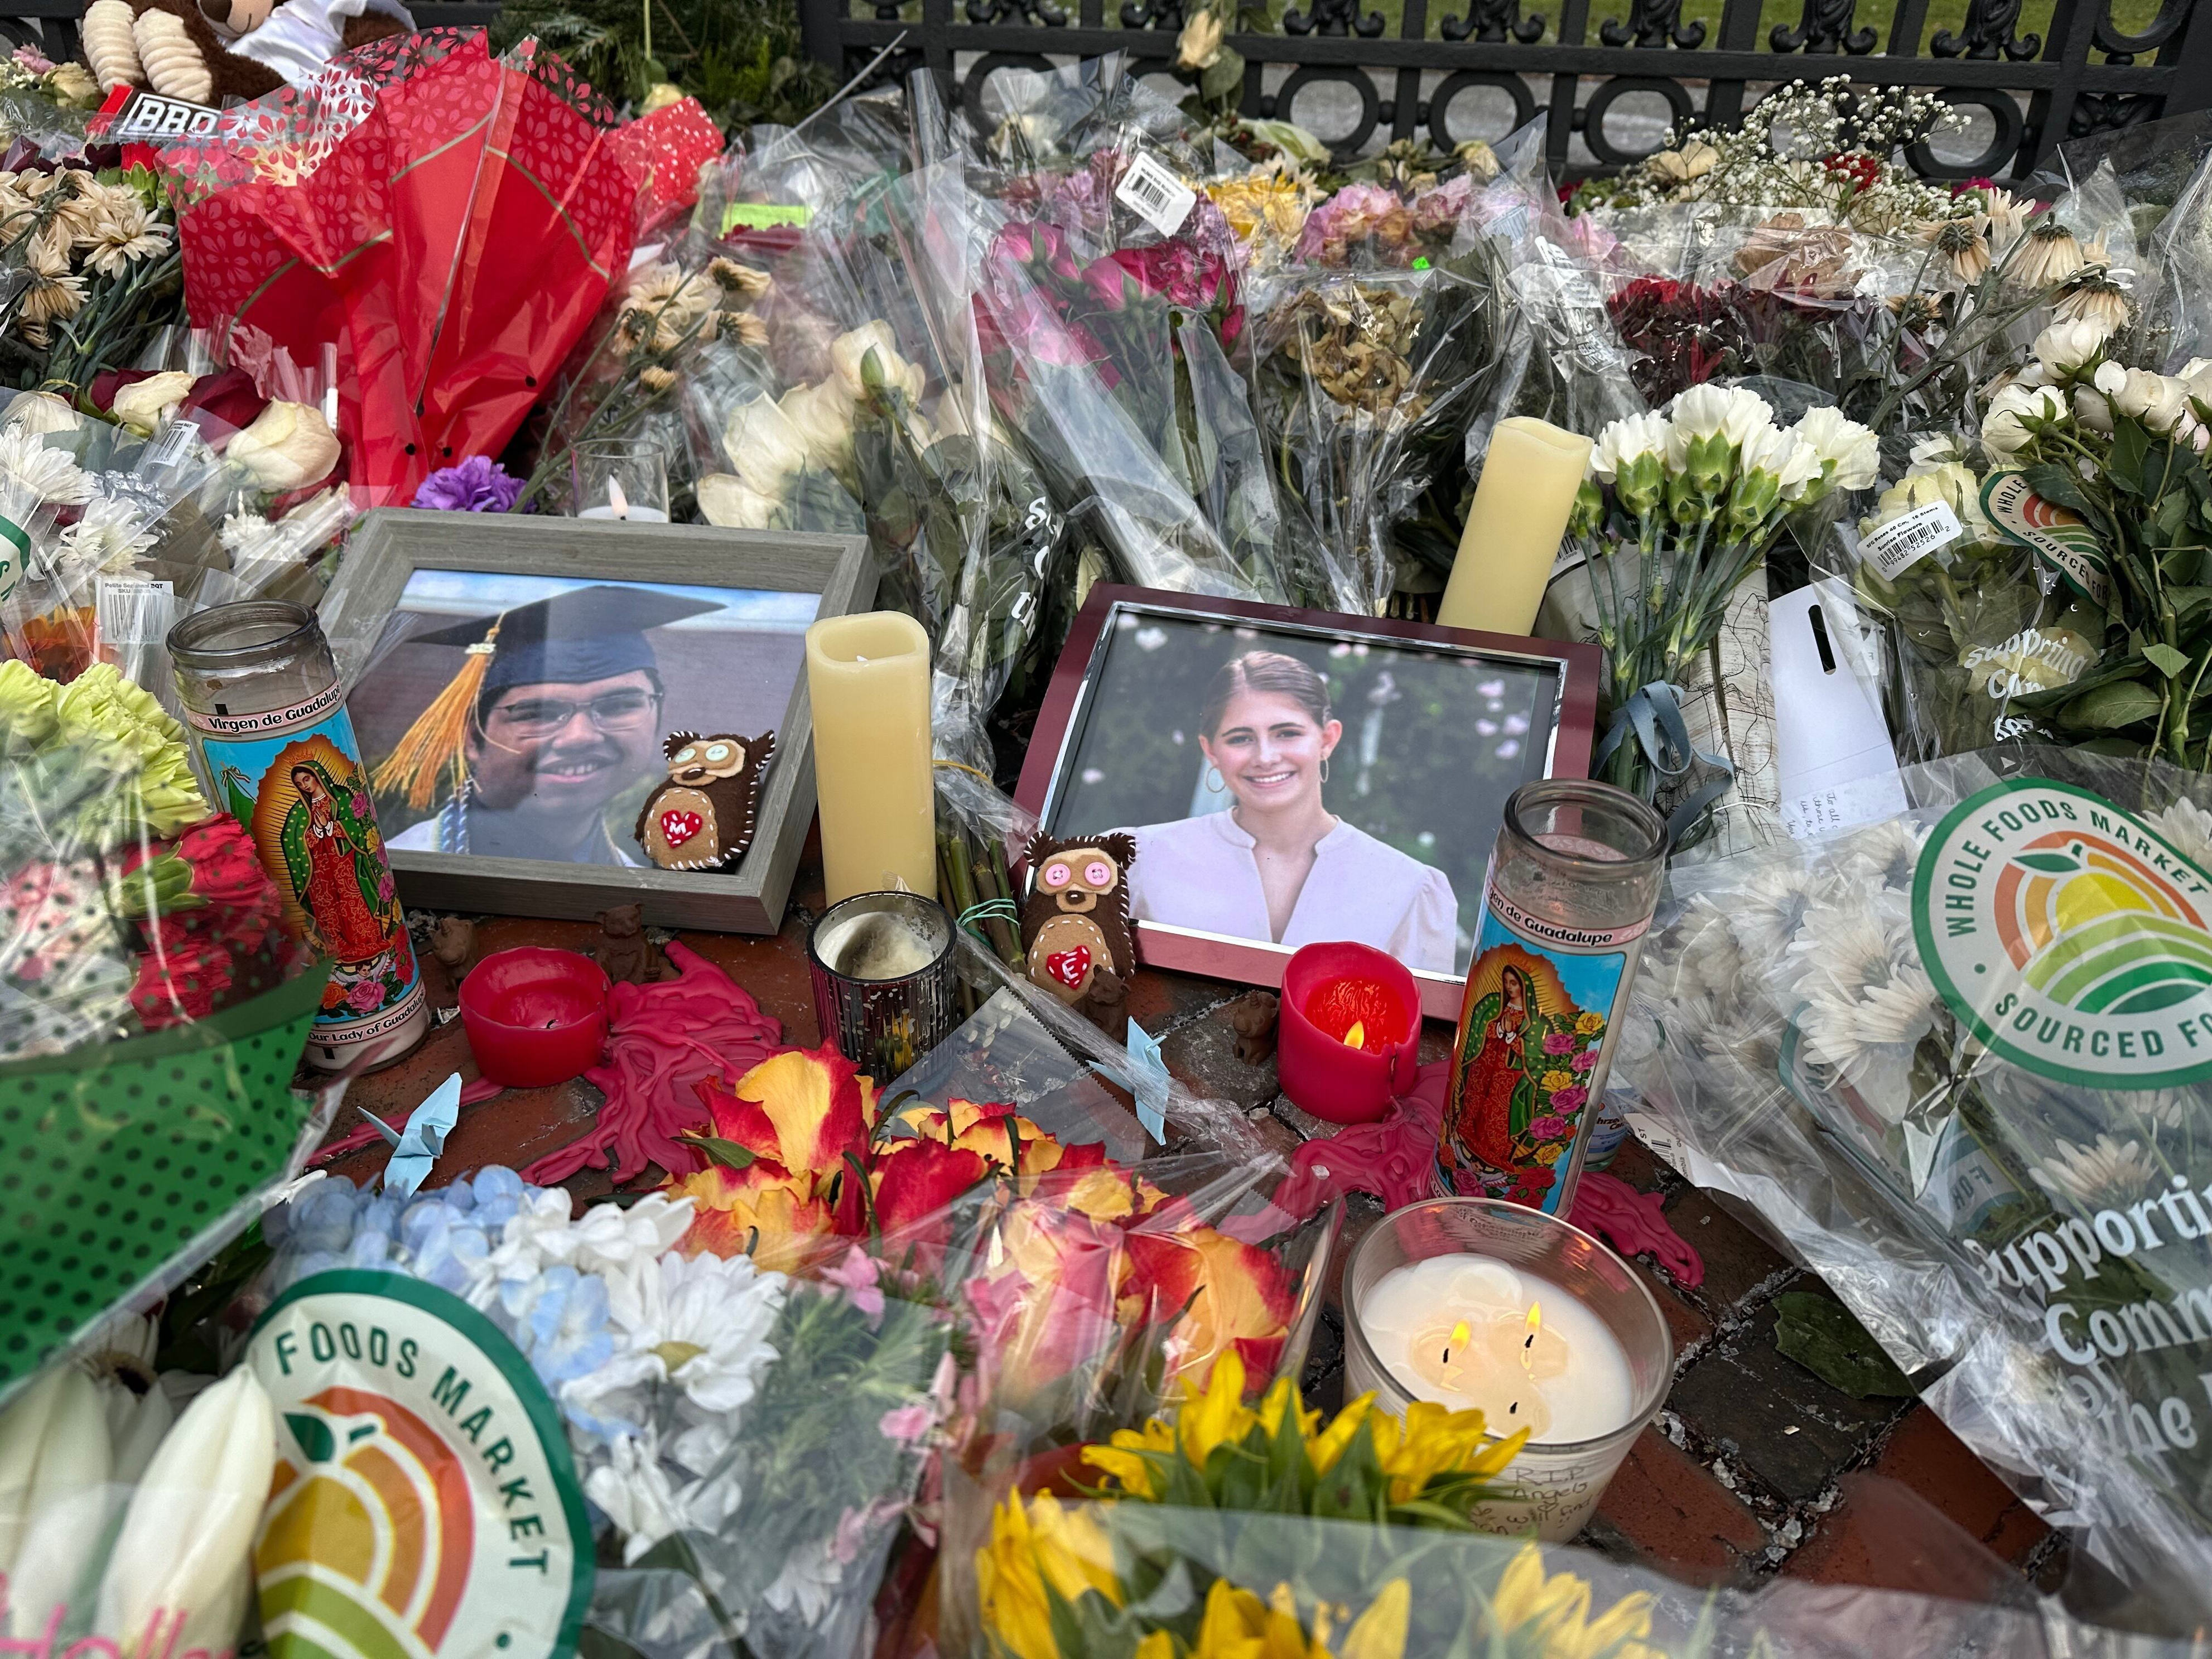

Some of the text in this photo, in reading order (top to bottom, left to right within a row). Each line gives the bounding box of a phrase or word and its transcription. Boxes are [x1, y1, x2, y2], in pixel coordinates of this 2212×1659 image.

[1997, 479, 2027, 513] WHOLE
[1875, 531, 1889, 542] Roses
[1920, 507, 1939, 516] Stems
[1877, 522, 1922, 551] Sunrise Flowers
[1890, 549, 1909, 566] 99482
[1910, 534, 1936, 551] 52526
[2023, 532, 2108, 600] SOURCED FOR
[208, 684, 340, 732] Virgen de Guadalupe
[669, 822, 687, 835] M
[1945, 800, 2209, 938] WHOLE FOODS MARKET
[1506, 906, 1522, 922] de
[1524, 917, 1613, 946] Guadalupe
[1062, 957, 1078, 980] E
[309, 990, 425, 1041] Our Lady of Guadalupe
[1995, 992, 2164, 1058] SOURCED
[274, 1322, 550, 1576] FOODS MARKET
